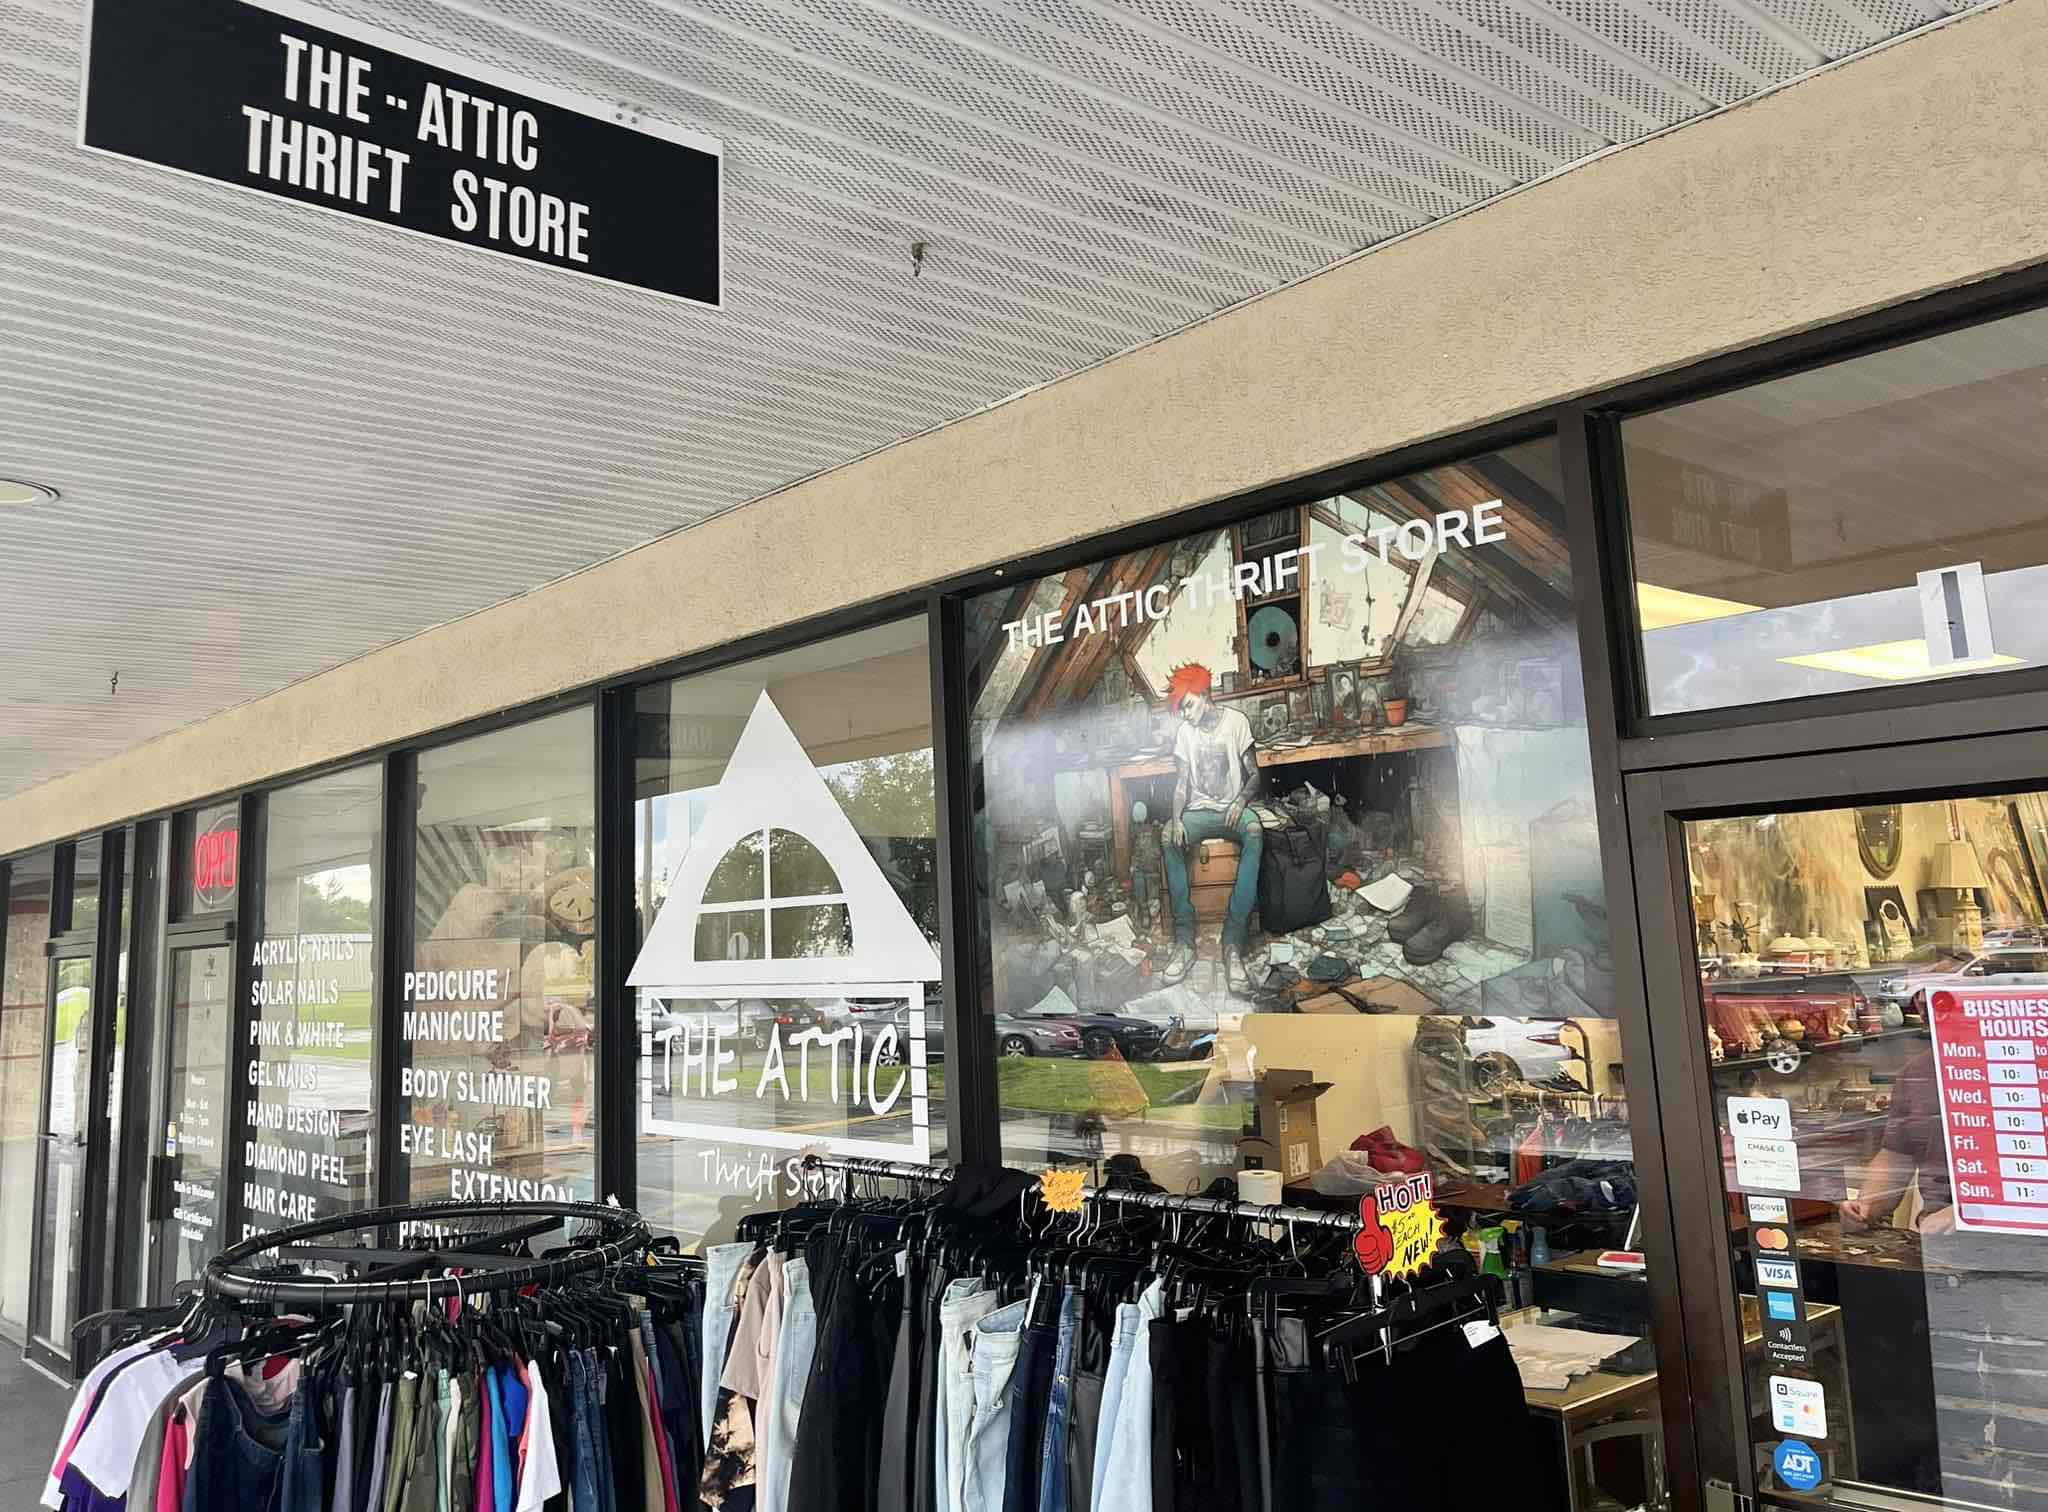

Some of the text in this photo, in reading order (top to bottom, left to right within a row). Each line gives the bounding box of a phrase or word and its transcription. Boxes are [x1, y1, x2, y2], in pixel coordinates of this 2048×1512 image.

[280, 33, 371, 123] THE
[416, 82, 539, 171] ATTIC
[241, 105, 590, 263] THRIFT STORE
[1002, 499, 1507, 653] THE ATTIC THRIFT STORE
[252, 934, 354, 966] ACRYLIC NAILS
[251, 978, 340, 1006] SOLAR NAILS
[404, 969, 499, 1001] PEDICURE
[250, 1020, 345, 1049] PINK & WHITE
[403, 1010, 504, 1042] MANICURE
[1979, 1019, 2048, 1038] HOURS
[1942, 1042, 2048, 1057] Mon. 10: to
[248, 1060, 318, 1091] GEL NAILS
[655, 1014, 907, 1116] THE ATTIC
[1945, 1065, 1986, 1081] Tues.
[2002, 1069, 2021, 1080] 10:
[401, 1067, 552, 1110] BODY SLIMMER
[1948, 1088, 1987, 1104] Wed.
[2005, 1092, 2024, 1103] 10:
[247, 1101, 341, 1138] HAND DESIGN
[1751, 1110, 1780, 1129] Pay
[1951, 1112, 2025, 1128] Thur. 10:
[401, 1123, 493, 1166] EYE LASH
[1747, 1143, 1776, 1153] CHASE
[1953, 1135, 2032, 1150] Fri. 10:
[245, 1141, 349, 1185] DIAMOND PEEL
[698, 1147, 781, 1202] Thrift
[1957, 1158, 2033, 1174] Sat. 10:
[243, 1183, 317, 1223] HAIR CARE
[1376, 1172, 1431, 1213] HOT!
[1959, 1181, 1995, 1198] Sun.
[1402, 1217, 1434, 1268] NEW!
[1764, 1267, 1793, 1280] VISA
[1767, 1340, 1807, 1353] Contactless
[1772, 1351, 1805, 1362] Accepted
[1782, 1453, 1815, 1474] ADT
